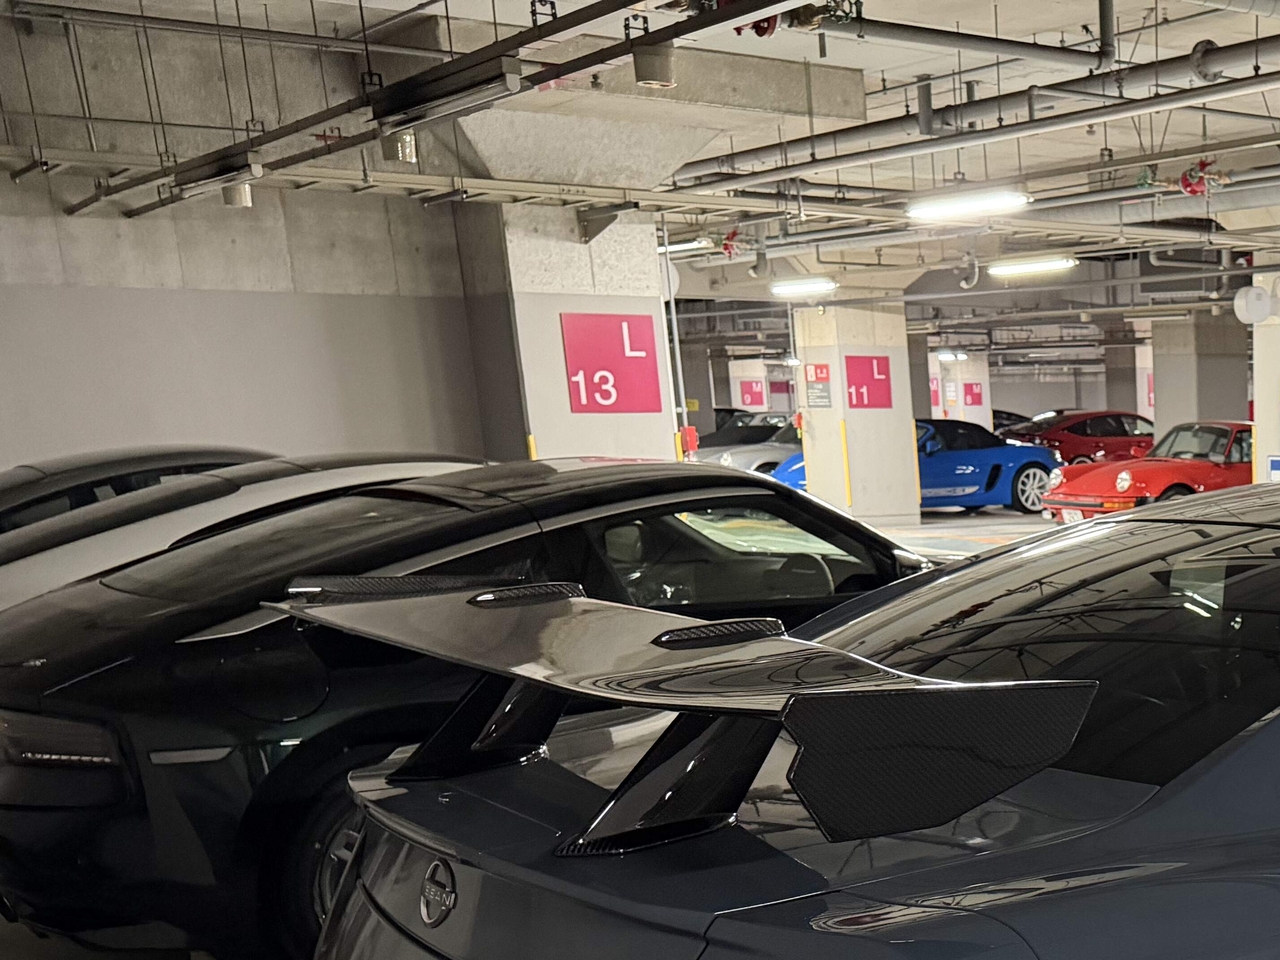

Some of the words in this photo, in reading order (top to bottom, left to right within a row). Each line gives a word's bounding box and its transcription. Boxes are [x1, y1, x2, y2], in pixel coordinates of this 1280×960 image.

[621, 321, 647, 357] L
[872, 358, 886, 379] L
[571, 369, 618, 406] 13
[751, 381, 762, 393] M
[848, 385, 868, 405] 11
[972, 384, 981, 393] M
[744, 393, 752, 405] 9
